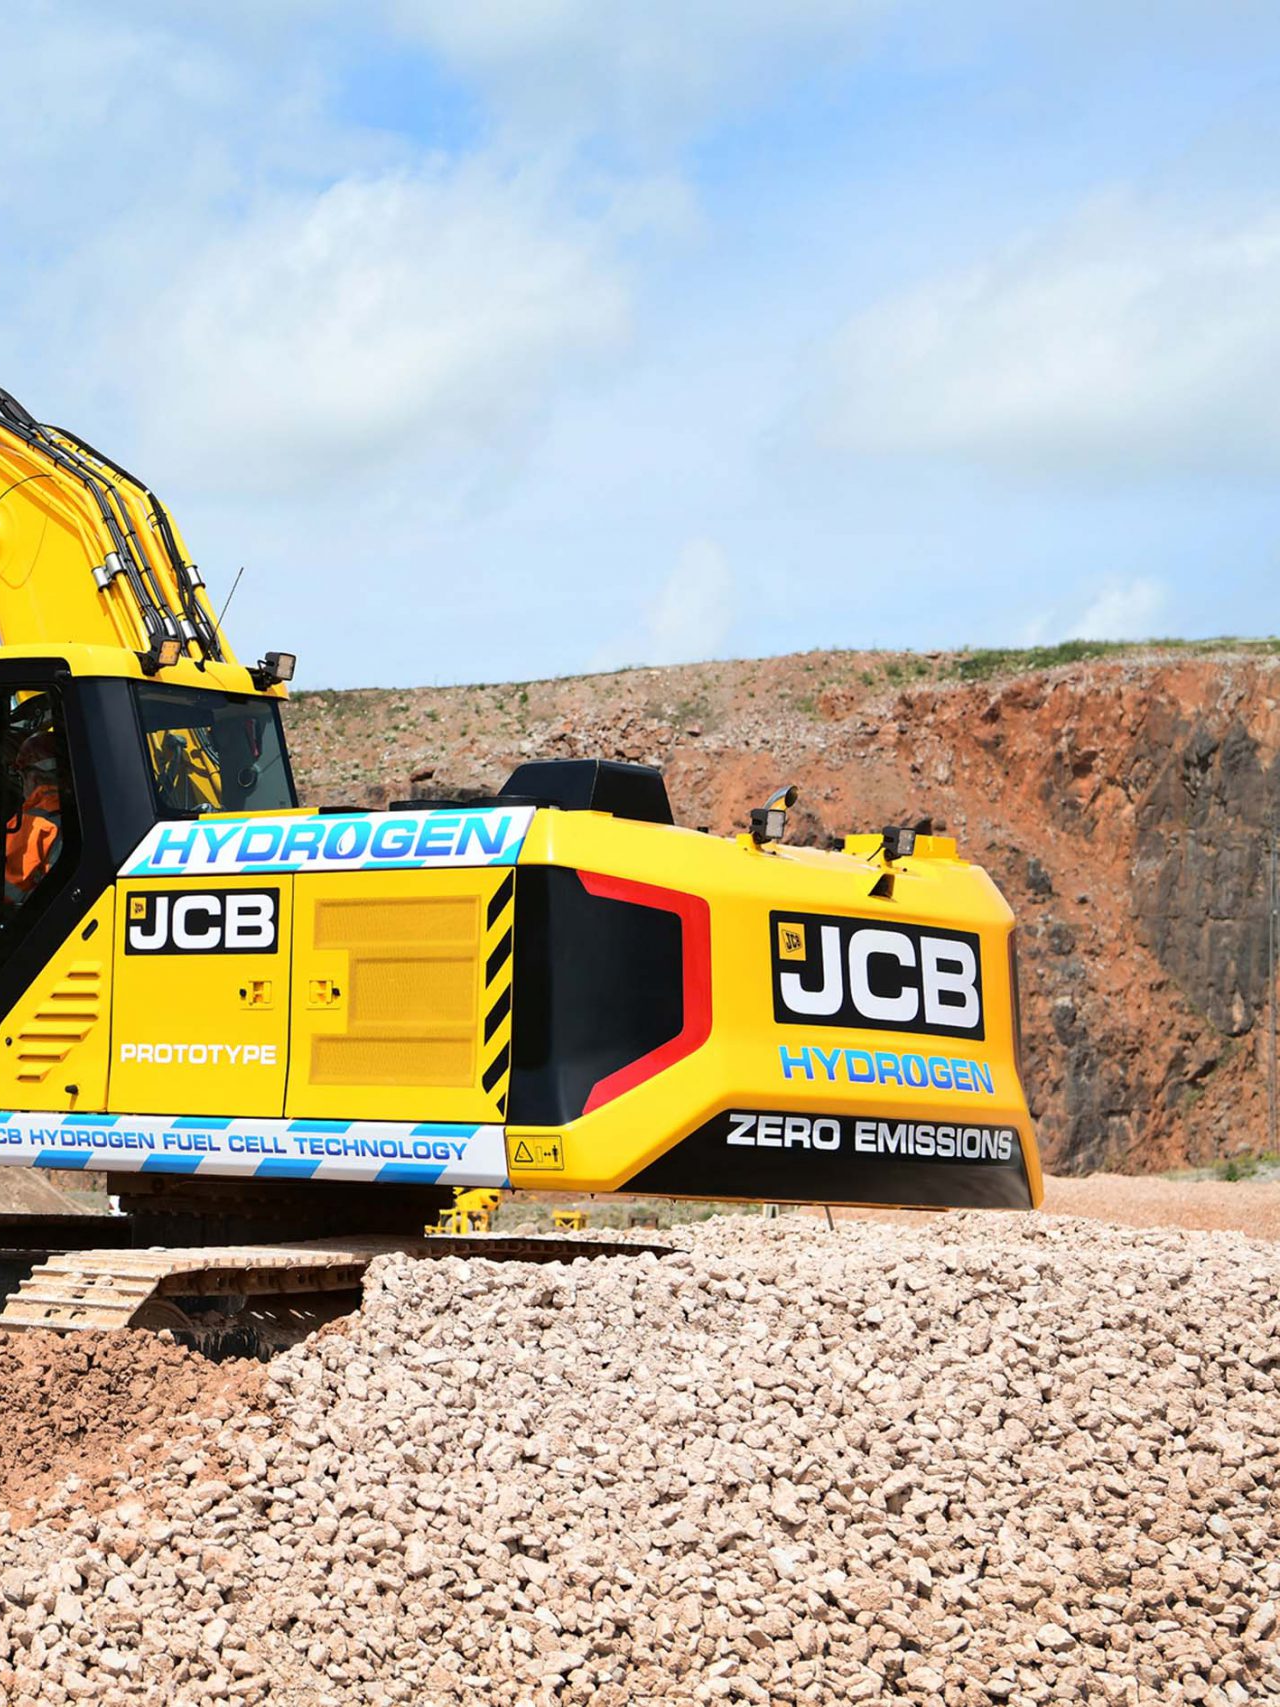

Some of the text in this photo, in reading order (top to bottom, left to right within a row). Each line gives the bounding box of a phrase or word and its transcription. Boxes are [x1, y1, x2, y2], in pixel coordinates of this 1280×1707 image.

[151, 816, 512, 865] HYDROGEN
[129, 894, 275, 950] JCB
[785, 931, 801, 950] JCB
[780, 925, 980, 1029] JCB
[120, 1043, 277, 1065] PROTOTYPE
[778, 1045, 995, 1094] HYDROGEN
[30, 1128, 155, 1150] HYDROGEN
[162, 1133, 222, 1151] FUEL
[228, 1135, 287, 1154] CELL
[293, 1137, 468, 1160] TECHNOLOGY
[726, 1113, 1013, 1160] ZERO EMISSIONS
